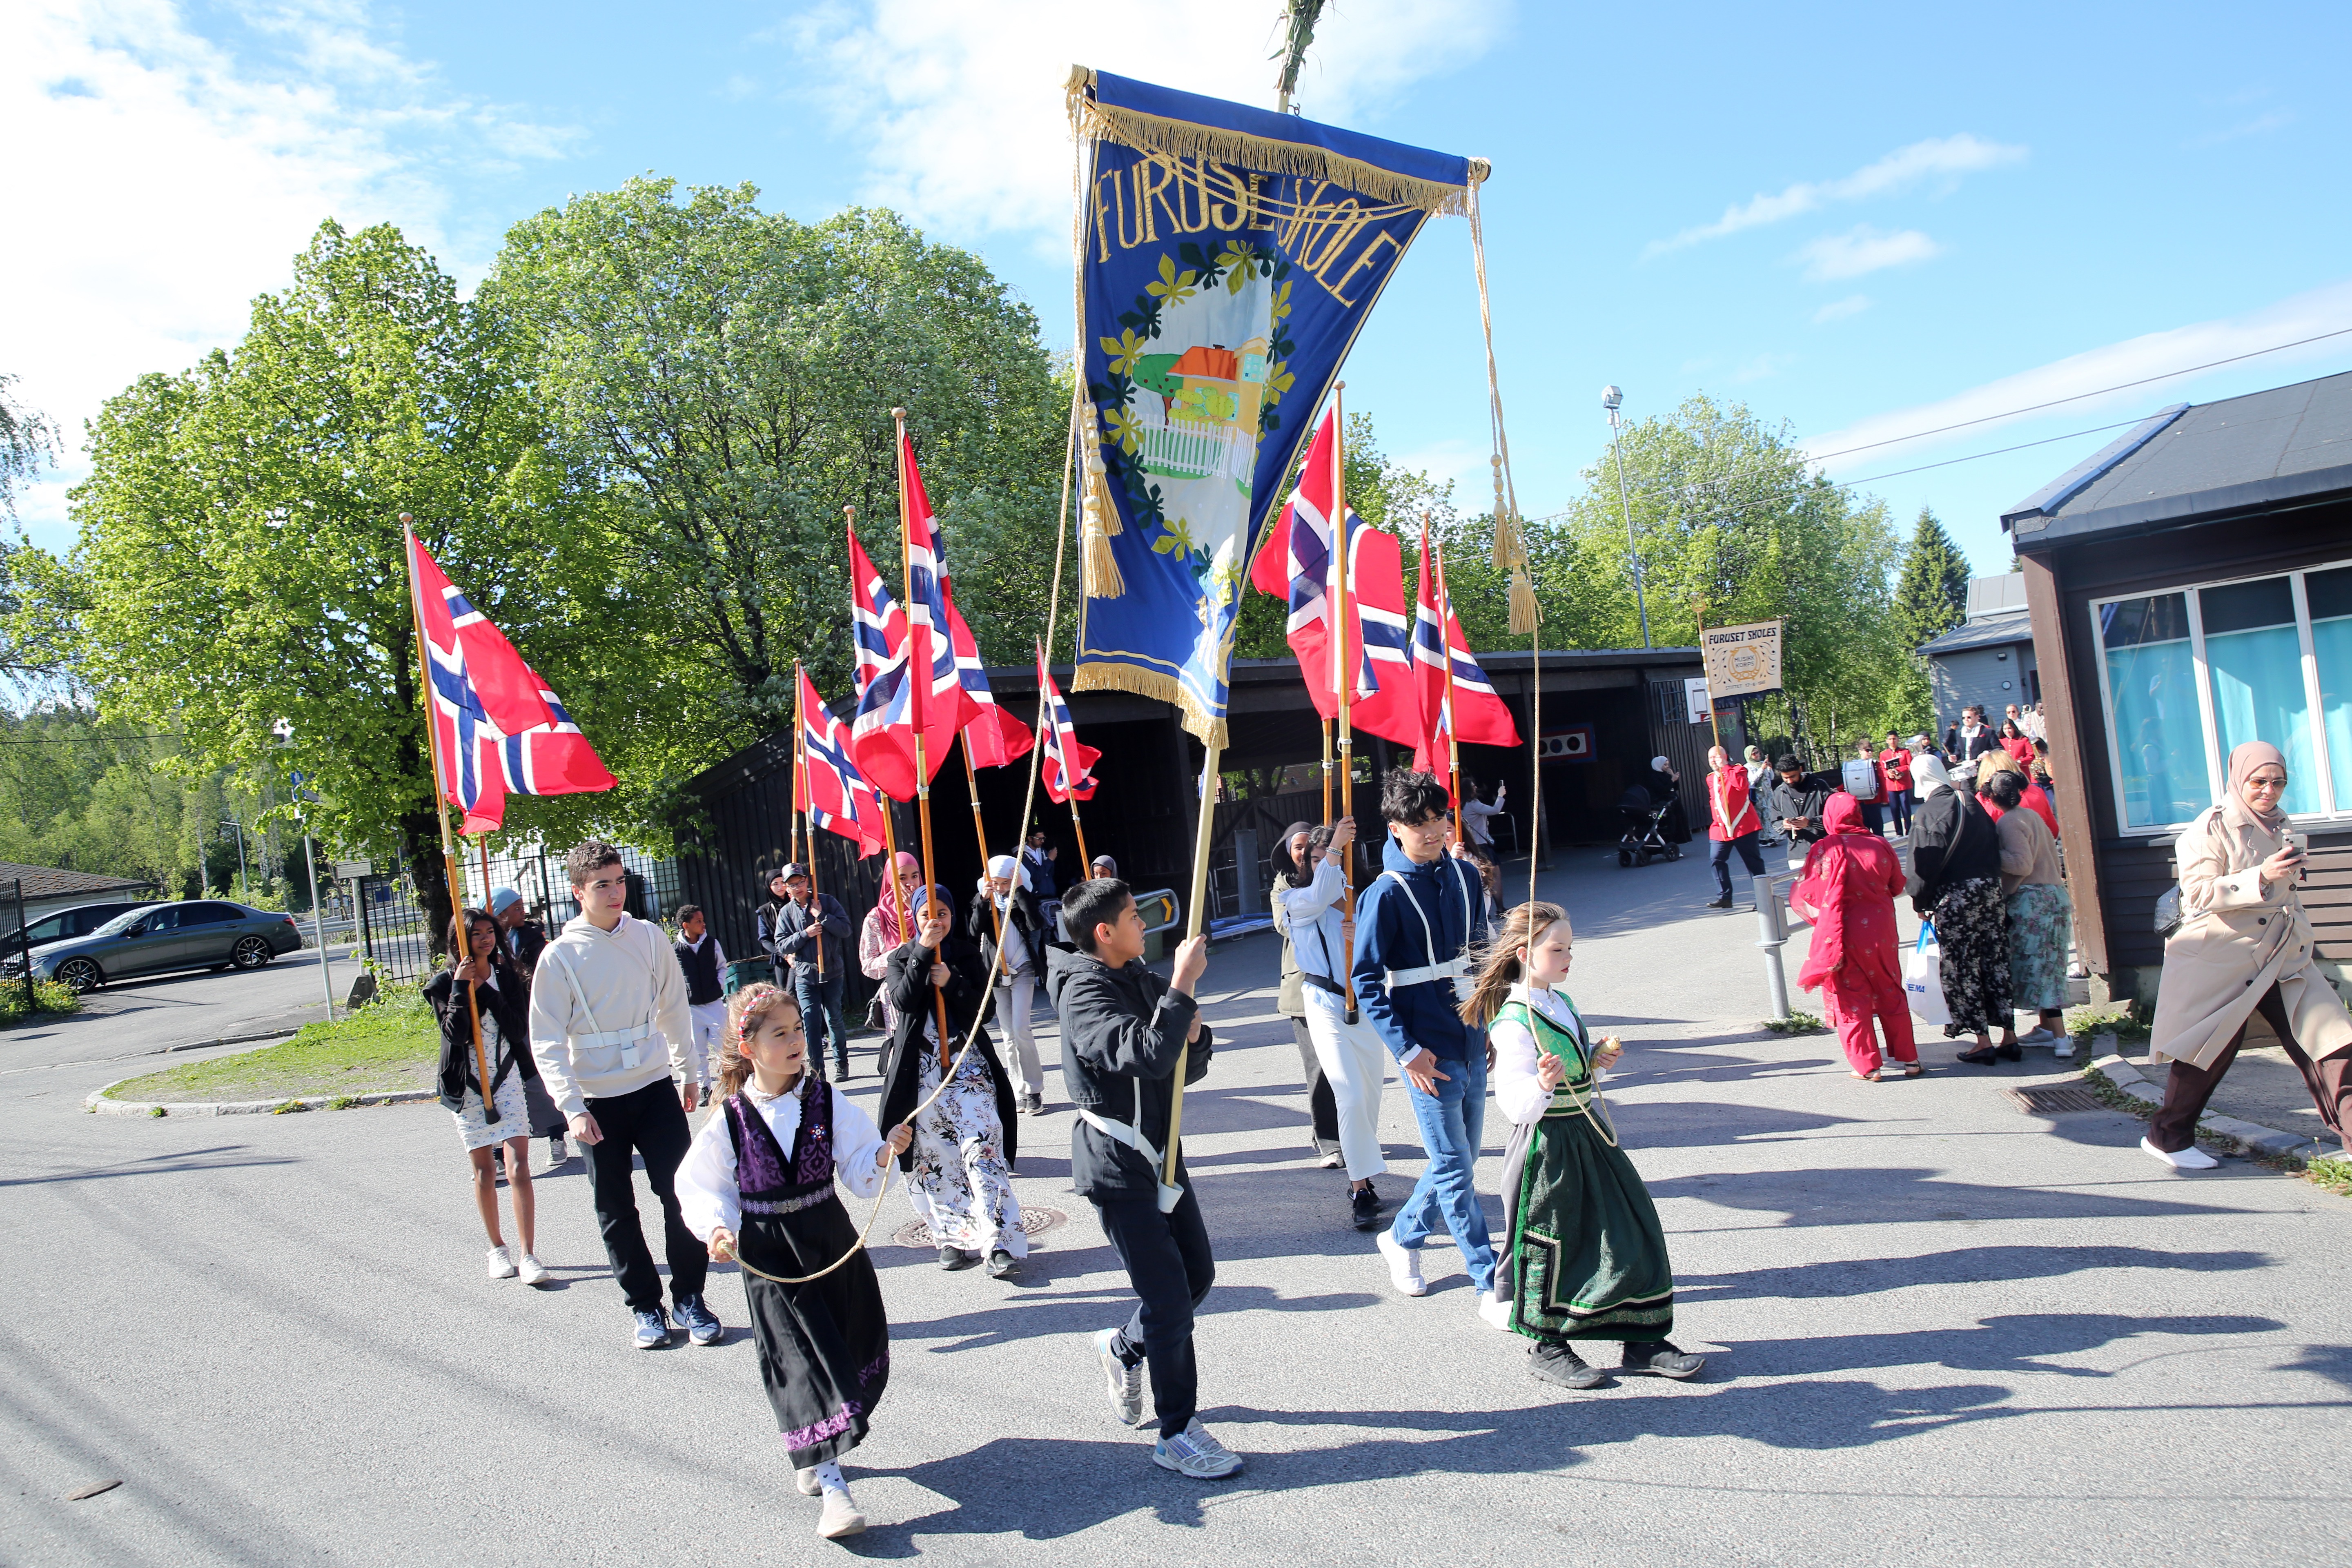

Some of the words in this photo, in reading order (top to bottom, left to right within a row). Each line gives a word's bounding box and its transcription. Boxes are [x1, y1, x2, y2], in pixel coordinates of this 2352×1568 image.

[1094, 149, 1285, 263] FURUSE
[1709, 632, 1745, 644] FURUSET
[1748, 627, 1776, 640] SKOLES
